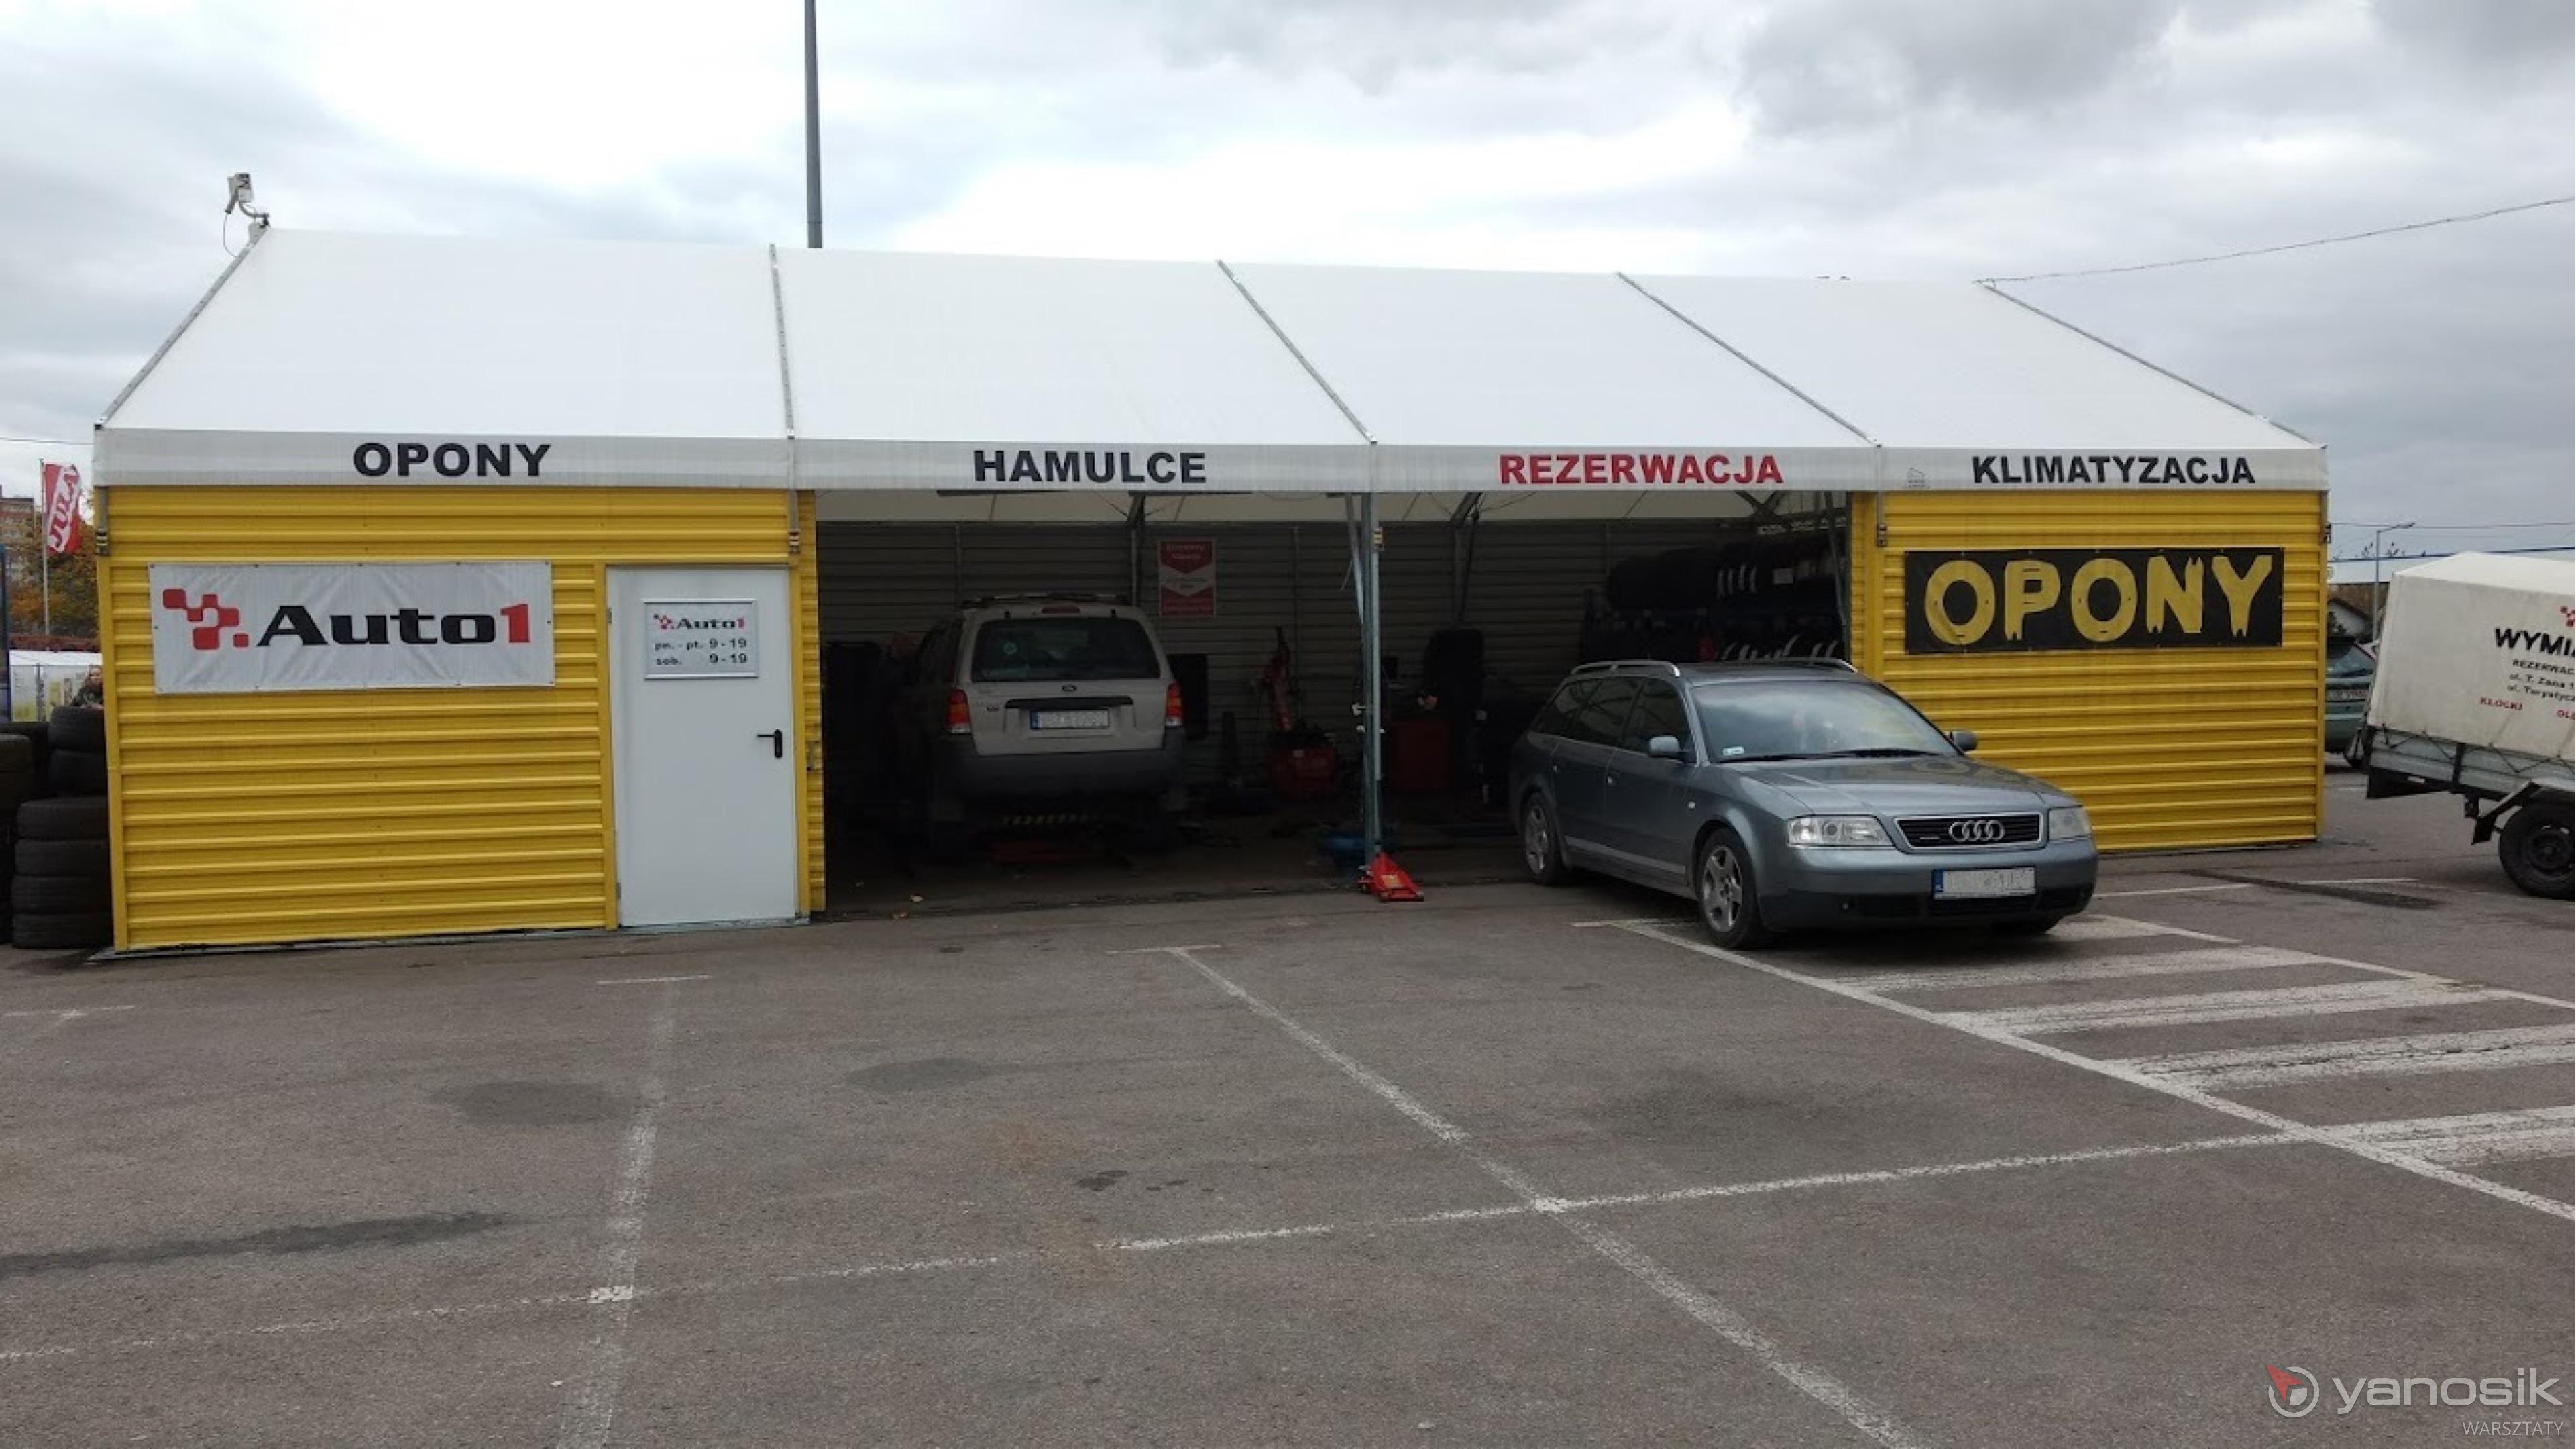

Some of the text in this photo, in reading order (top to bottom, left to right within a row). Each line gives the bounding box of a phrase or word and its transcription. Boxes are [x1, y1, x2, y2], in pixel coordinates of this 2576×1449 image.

[353, 443, 551, 478] OPONY
[974, 450, 1207, 484] HAMULCE
[1500, 454, 1783, 484] REZERWACJA
[1972, 455, 2256, 484] KLIMATYZACJA
[1924, 554, 2274, 646] OPONY
[256, 604, 530, 647] Auto1
[676, 617, 745, 629] Auto1
[2495, 627, 2575, 657] WYMI
[2480, 696, 2523, 711] KLOCKI
